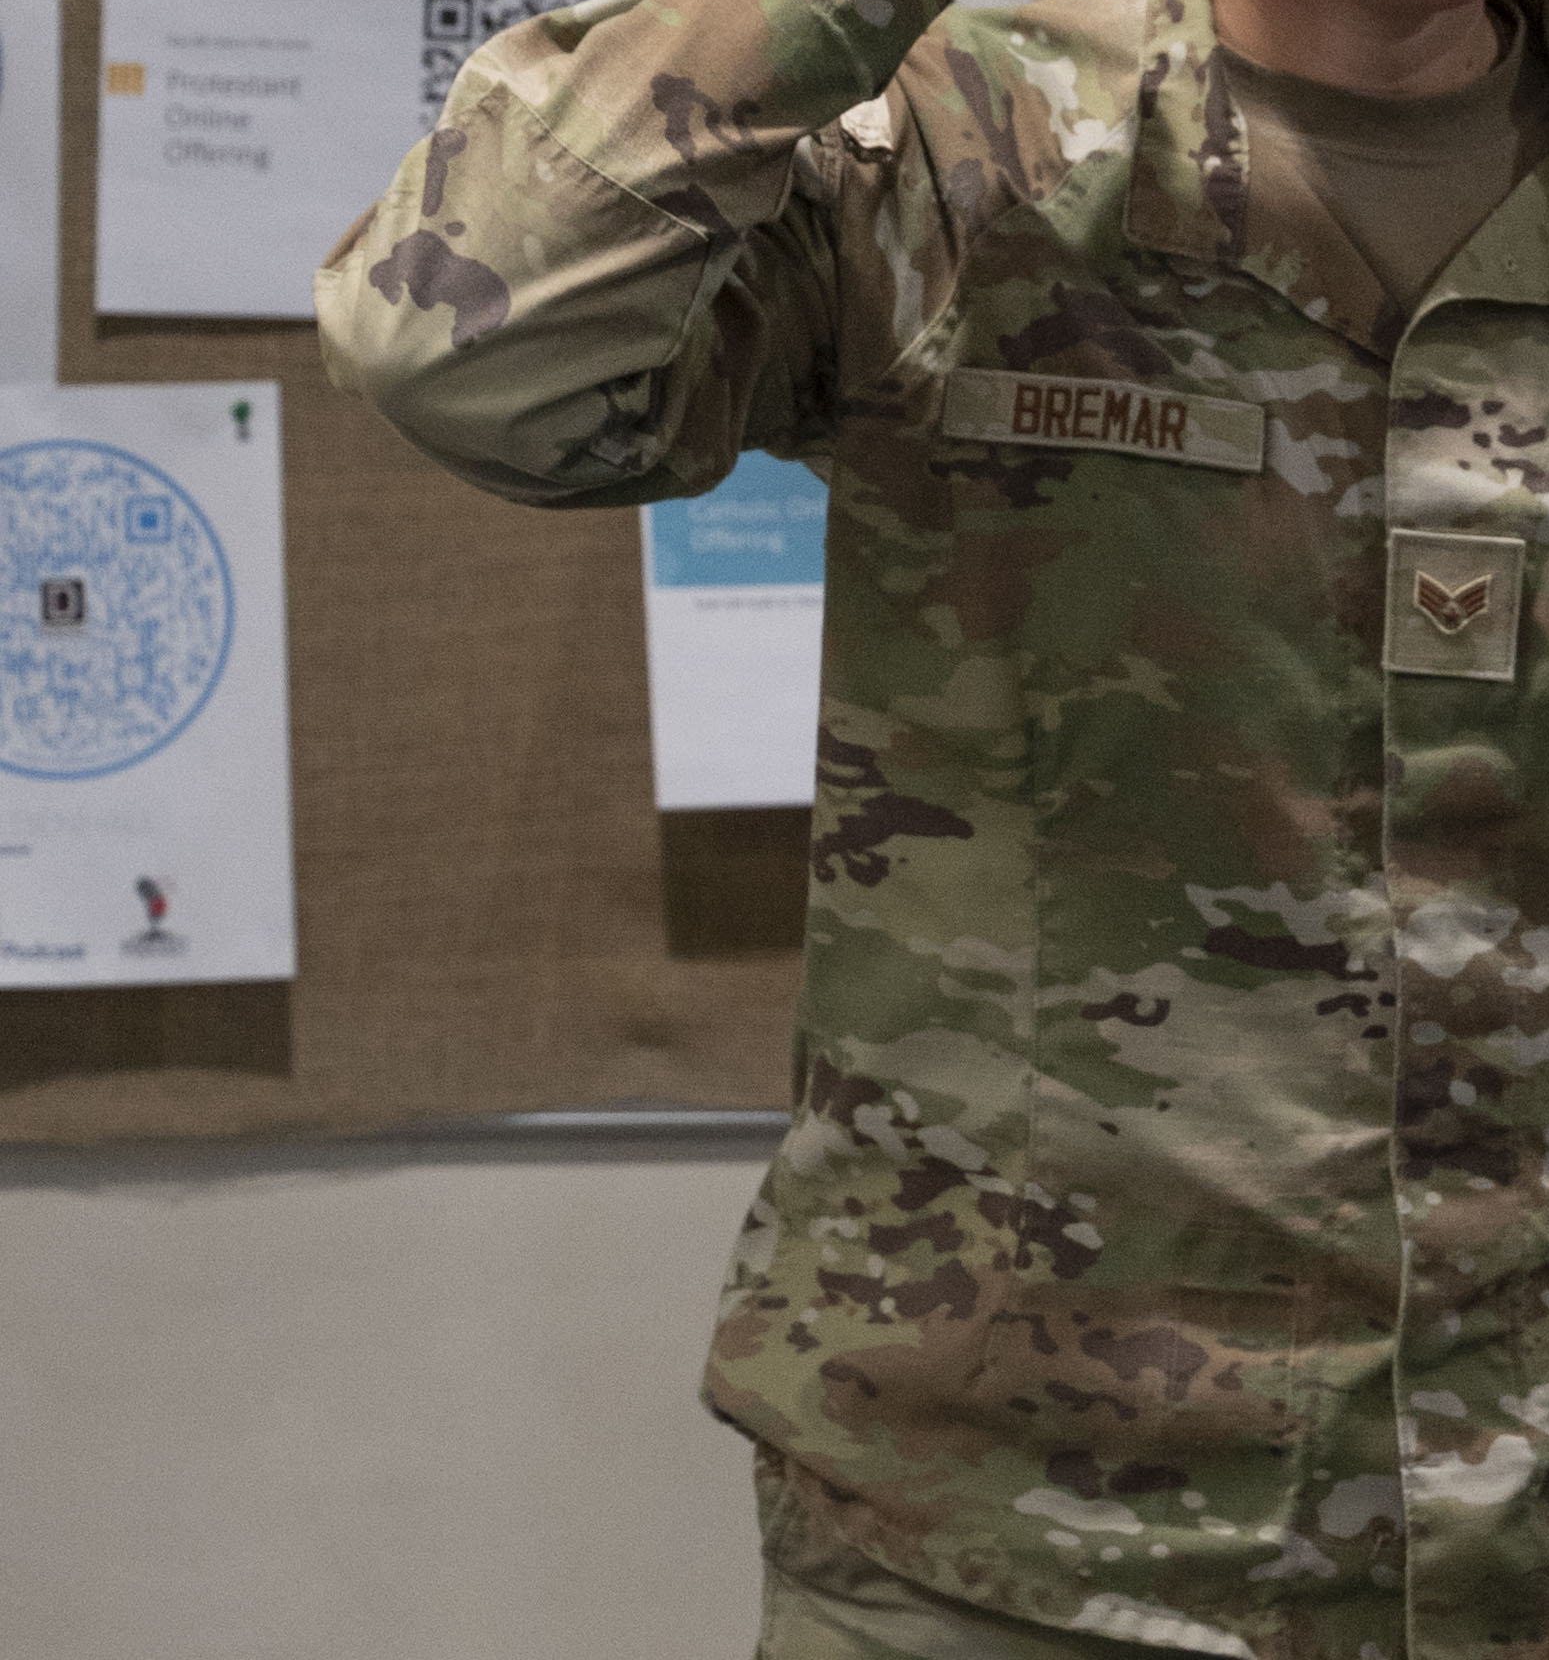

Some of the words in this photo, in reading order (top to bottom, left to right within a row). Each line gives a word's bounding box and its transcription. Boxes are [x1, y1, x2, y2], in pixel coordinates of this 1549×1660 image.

[165, 67, 302, 97] Protestant
[163, 101, 251, 130] Online
[162, 138, 270, 172] Offering
[1012, 383, 1188, 451] BREMAR
